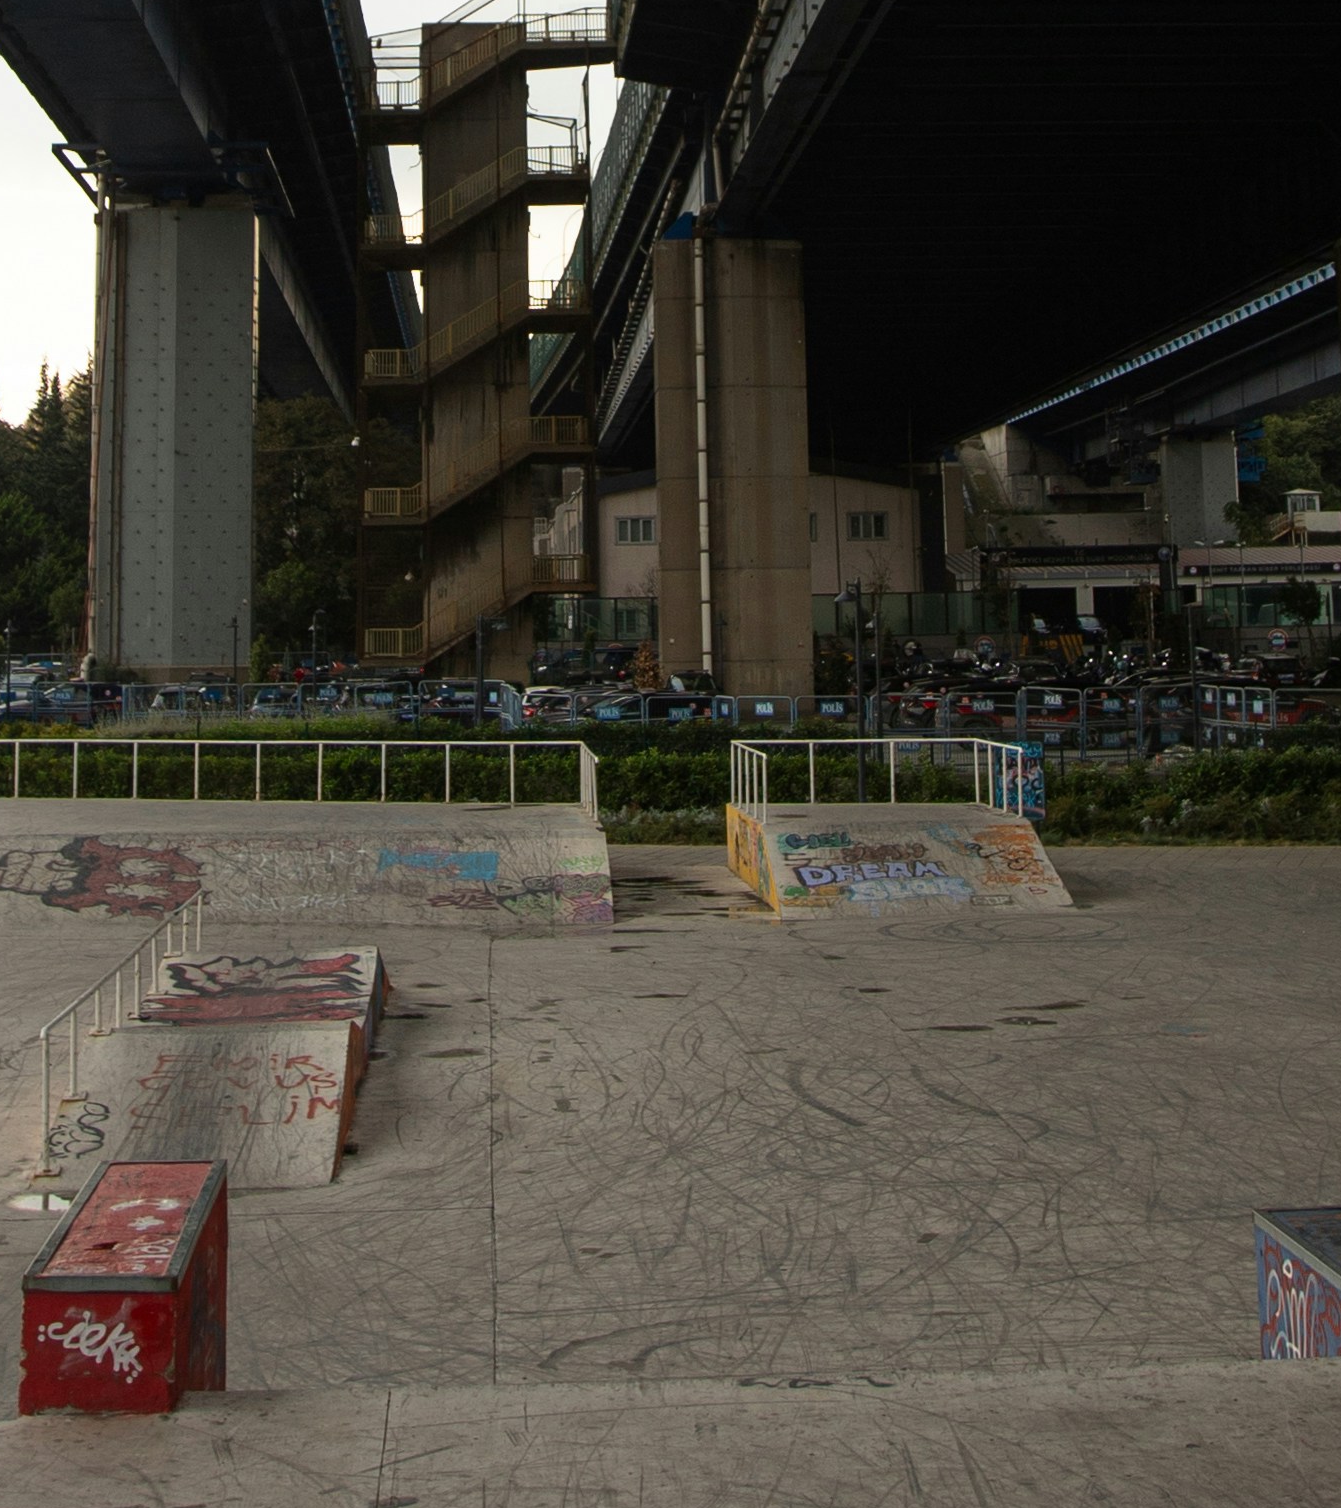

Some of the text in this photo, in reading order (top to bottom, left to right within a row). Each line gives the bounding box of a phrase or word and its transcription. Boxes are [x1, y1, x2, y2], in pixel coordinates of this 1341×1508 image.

[973, 699, 995, 712] POLİS
[1043, 694, 1063, 705] POLİS
[755, 702, 774, 713] POLİS
[821, 701, 844, 714] POLİS
[792, 860, 948, 887] DREAM
